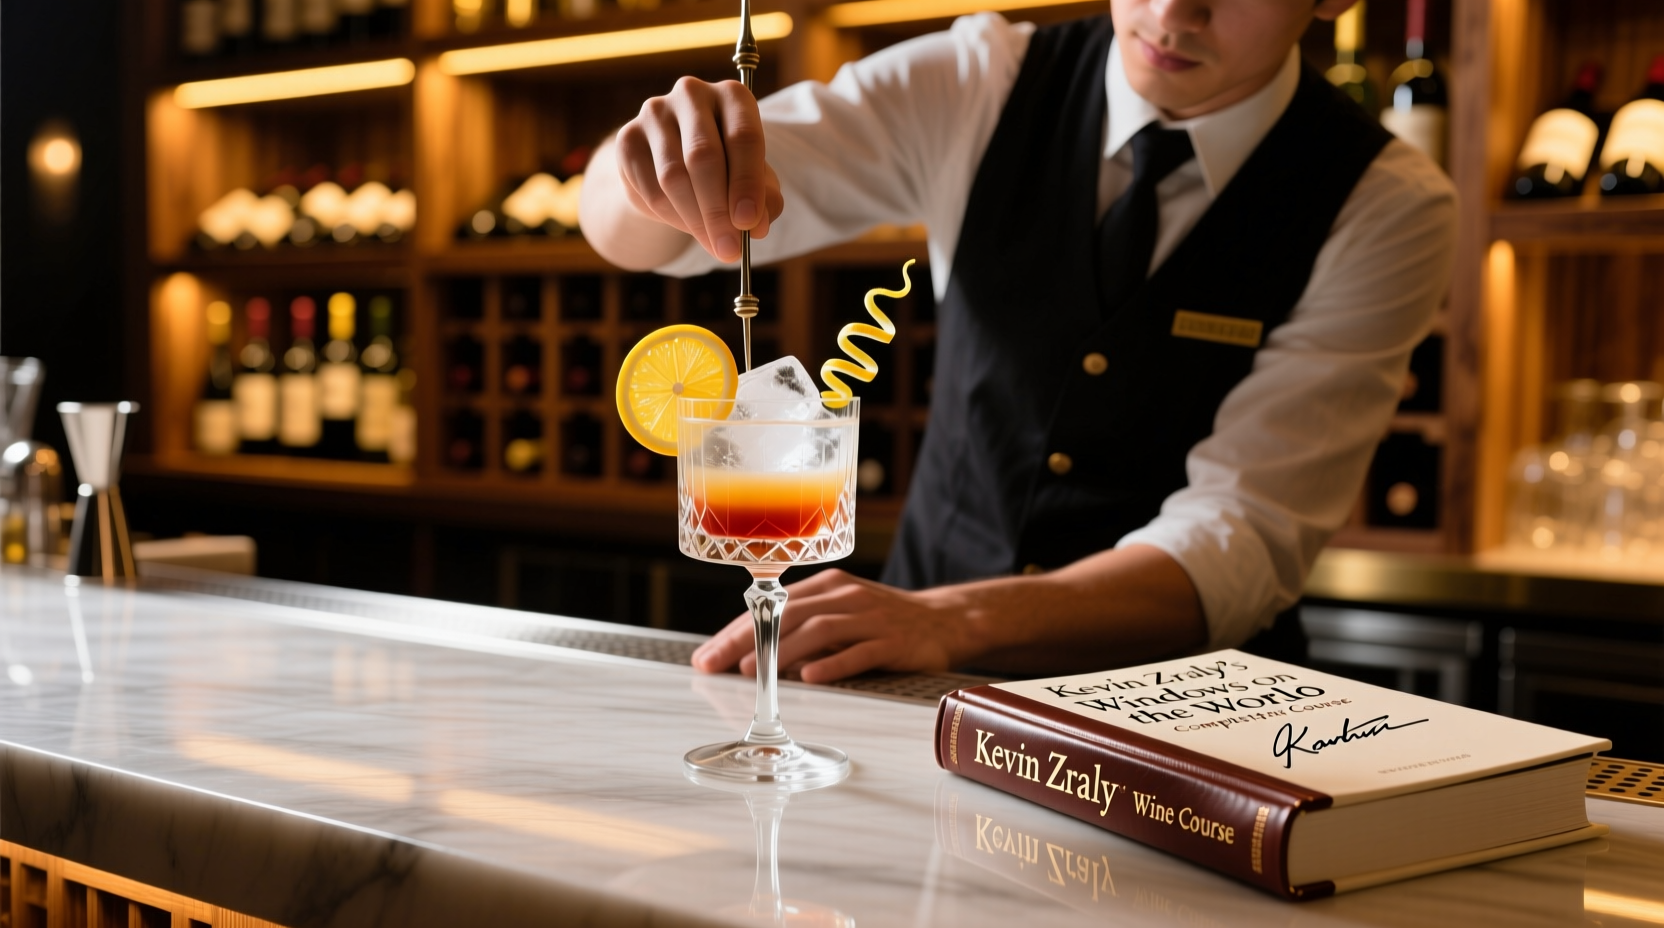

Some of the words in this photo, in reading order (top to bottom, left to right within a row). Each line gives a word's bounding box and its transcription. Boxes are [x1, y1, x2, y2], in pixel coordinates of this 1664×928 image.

[1042, 678, 1148, 698] Kevin
[1074, 682, 1249, 712] Windows
[1128, 709, 1194, 724] the
[974, 728, 1040, 782] Kevin
[1133, 791, 1174, 825] Wine
[1179, 807, 1234, 844] Course
